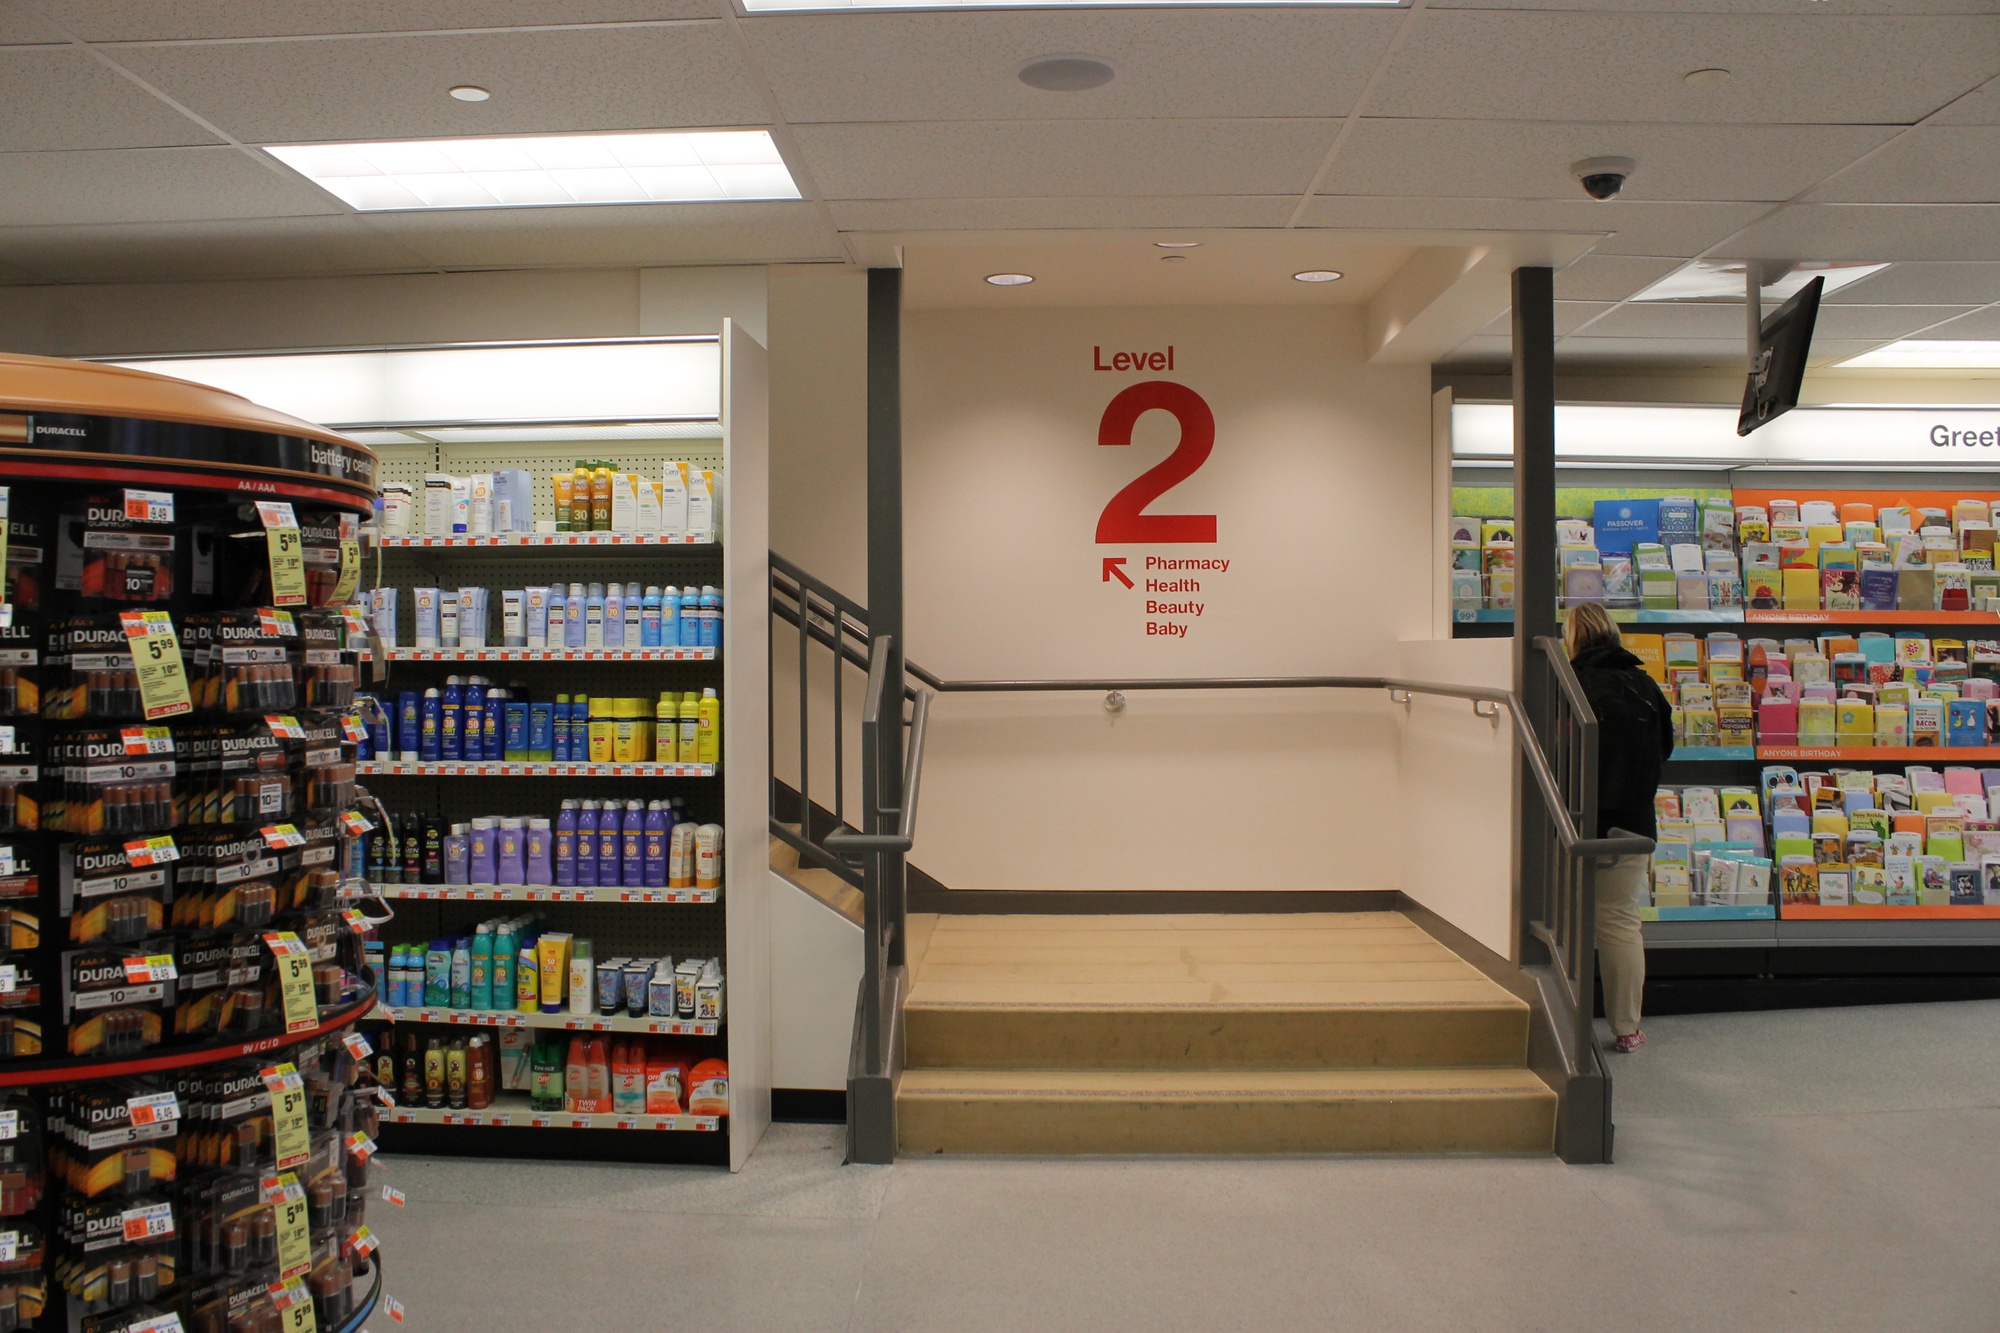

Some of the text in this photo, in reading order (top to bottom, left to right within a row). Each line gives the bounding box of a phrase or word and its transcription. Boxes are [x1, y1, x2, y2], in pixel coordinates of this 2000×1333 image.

[1094, 346, 1174, 371] Level
[36, 426, 87, 437] DURACELL
[311, 445, 373, 476] battery center
[1095, 380, 1217, 544] 2
[238, 481, 251, 490] AA
[258, 483, 276, 493] AAA
[574, 510, 588, 521] 30
[594, 509, 608, 520] 50
[302, 526, 337, 540] DURACELL
[1145, 556, 1230, 572] Pharmacy
[126, 578, 140, 590] 10
[1146, 579, 1200, 592] Health
[609, 608, 618, 616] 70
[1146, 600, 1205, 616] Beauty
[1752, 613, 1830, 622] ANYONE BIRTHDAY
[73, 630, 127, 643] DURAC
[305, 628, 337, 641] DURACELL
[1146, 622, 1188, 638] Baby
[104, 655, 120, 667] 10
[246, 650, 258, 661] 10
[444, 719, 455, 727] 30
[468, 720, 479, 728] 50
[700, 719, 709, 728] 70
[306, 728, 337, 741] DURACELL
[88, 744, 127, 757] DURA
[222, 737, 279, 751] DURACELL
[1800, 750, 1842, 758] BIRTHDAY
[119, 766, 135, 779] 10
[261, 795, 272, 806] 10
[305, 826, 334, 841] DURACELL
[560, 846, 568, 854] 15
[580, 846, 590, 854] 30
[602, 846, 613, 854] 30
[626, 846, 636, 854] 50
[650, 846, 660, 854] 70
[84, 855, 130, 870] DURA
[239, 865, 251, 878] 10
[113, 877, 128, 891] 10
[233, 945, 260, 959] DURACELL
[80, 967, 126, 983] DURA
[109, 990, 125, 1003] 10
[223, 1074, 262, 1095] DURAC
[537, 1075, 550, 1083] OFF!
[622, 1078, 635, 1086] OFF!
[578, 1099, 597, 1107] TWIN
[92, 1105, 131, 1123] DURA
[128, 1128, 137, 1141] 5
[222, 1184, 255, 1201] DURACELL
[229, 1283, 269, 1304] DURACELL
